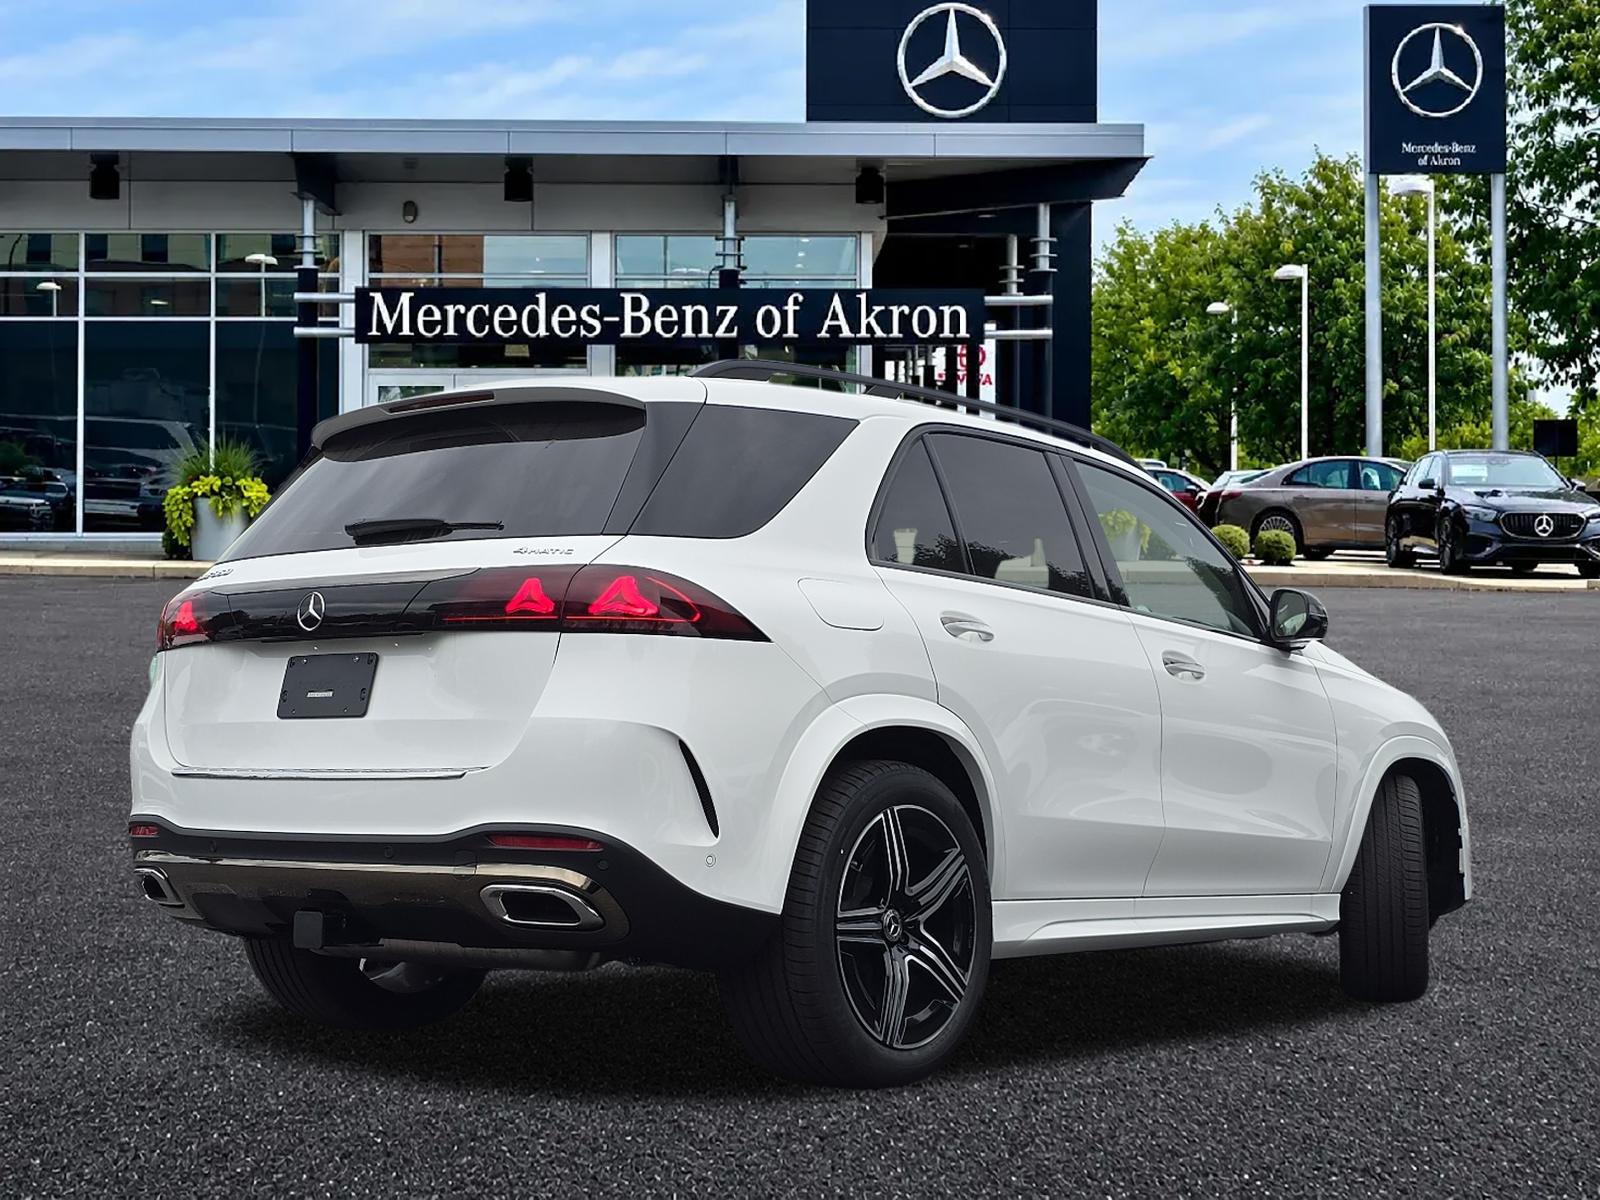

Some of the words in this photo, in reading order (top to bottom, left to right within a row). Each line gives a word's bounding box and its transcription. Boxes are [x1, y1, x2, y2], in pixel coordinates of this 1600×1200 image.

[1401, 141, 1476, 153] Mercedes-Benz
[1417, 154, 1428, 166] of
[1429, 154, 1461, 166] Akron
[367, 292, 738, 338] Mercedes-Benz
[756, 292, 804, 338] of
[816, 292, 970, 338] Akron
